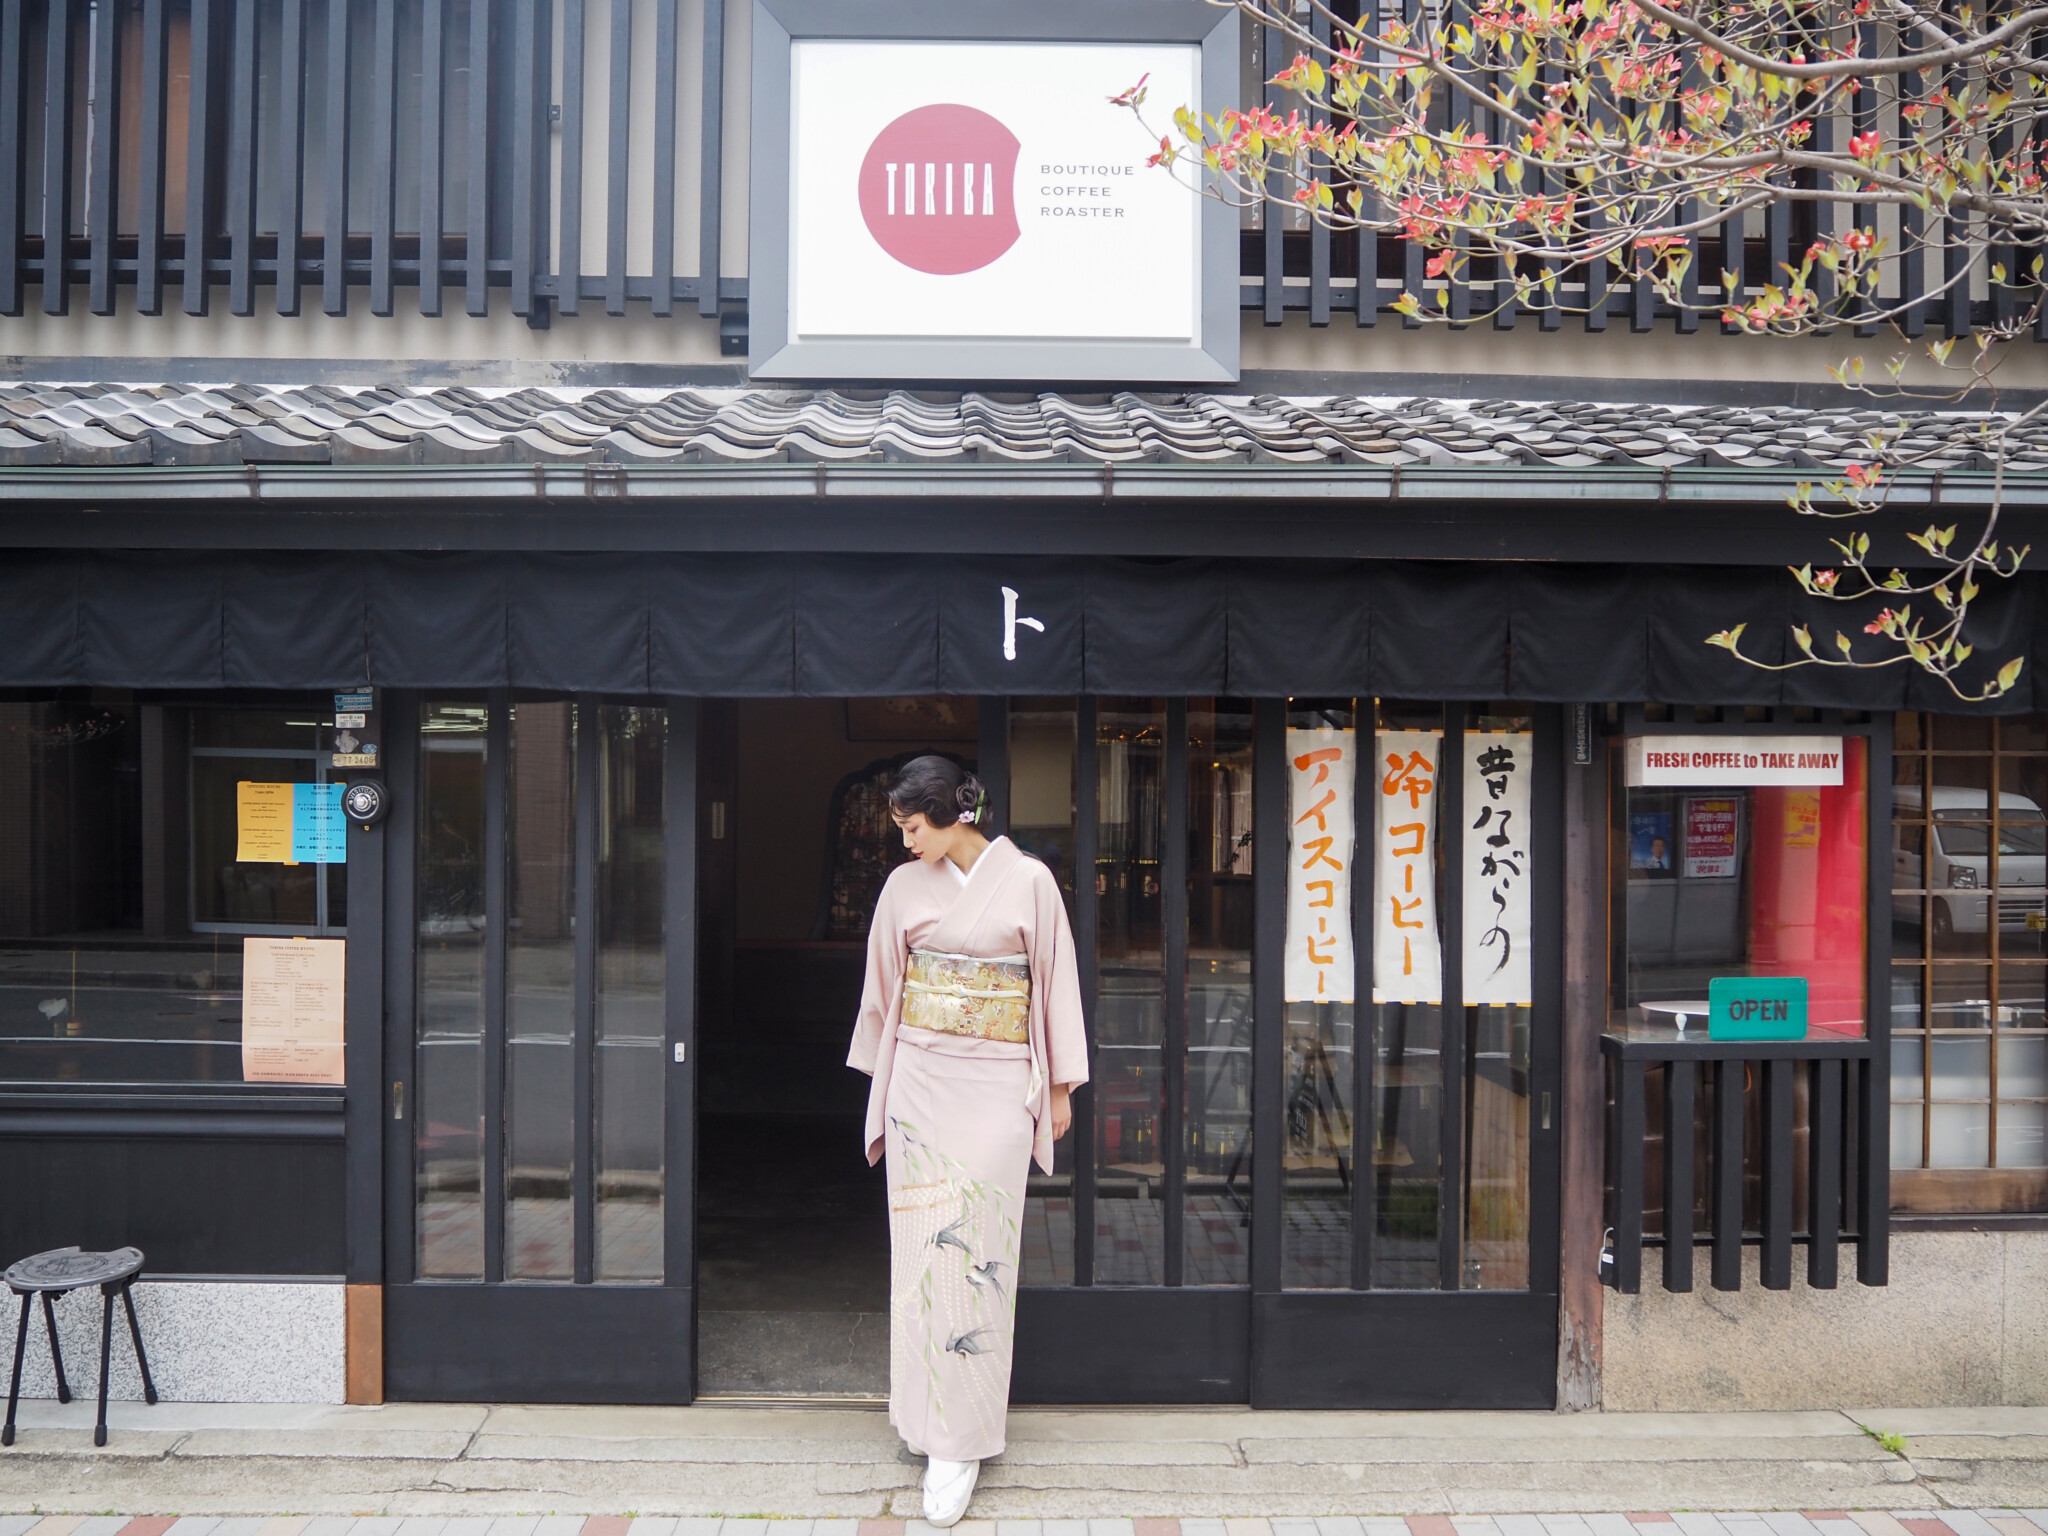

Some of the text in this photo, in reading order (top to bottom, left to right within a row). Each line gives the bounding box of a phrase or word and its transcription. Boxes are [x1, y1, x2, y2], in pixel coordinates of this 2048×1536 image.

[1040, 164, 1134, 177] BOUTIQUE
[1040, 186, 1112, 197] COFFEE
[1040, 206, 1125, 218] ROASTER
[1001, 586, 1045, 661] ト
[1646, 752, 1840, 769] FRESH COFFEE to TAKE AWAY
[349, 787, 377, 800] VISITORS
[1293, 747, 1343, 994] アイスコーヒー
[1382, 750, 1434, 976] 冷コーヒー
[1472, 744, 1525, 985] 昔ながらの
[1728, 999, 1789, 1022] OPEN
